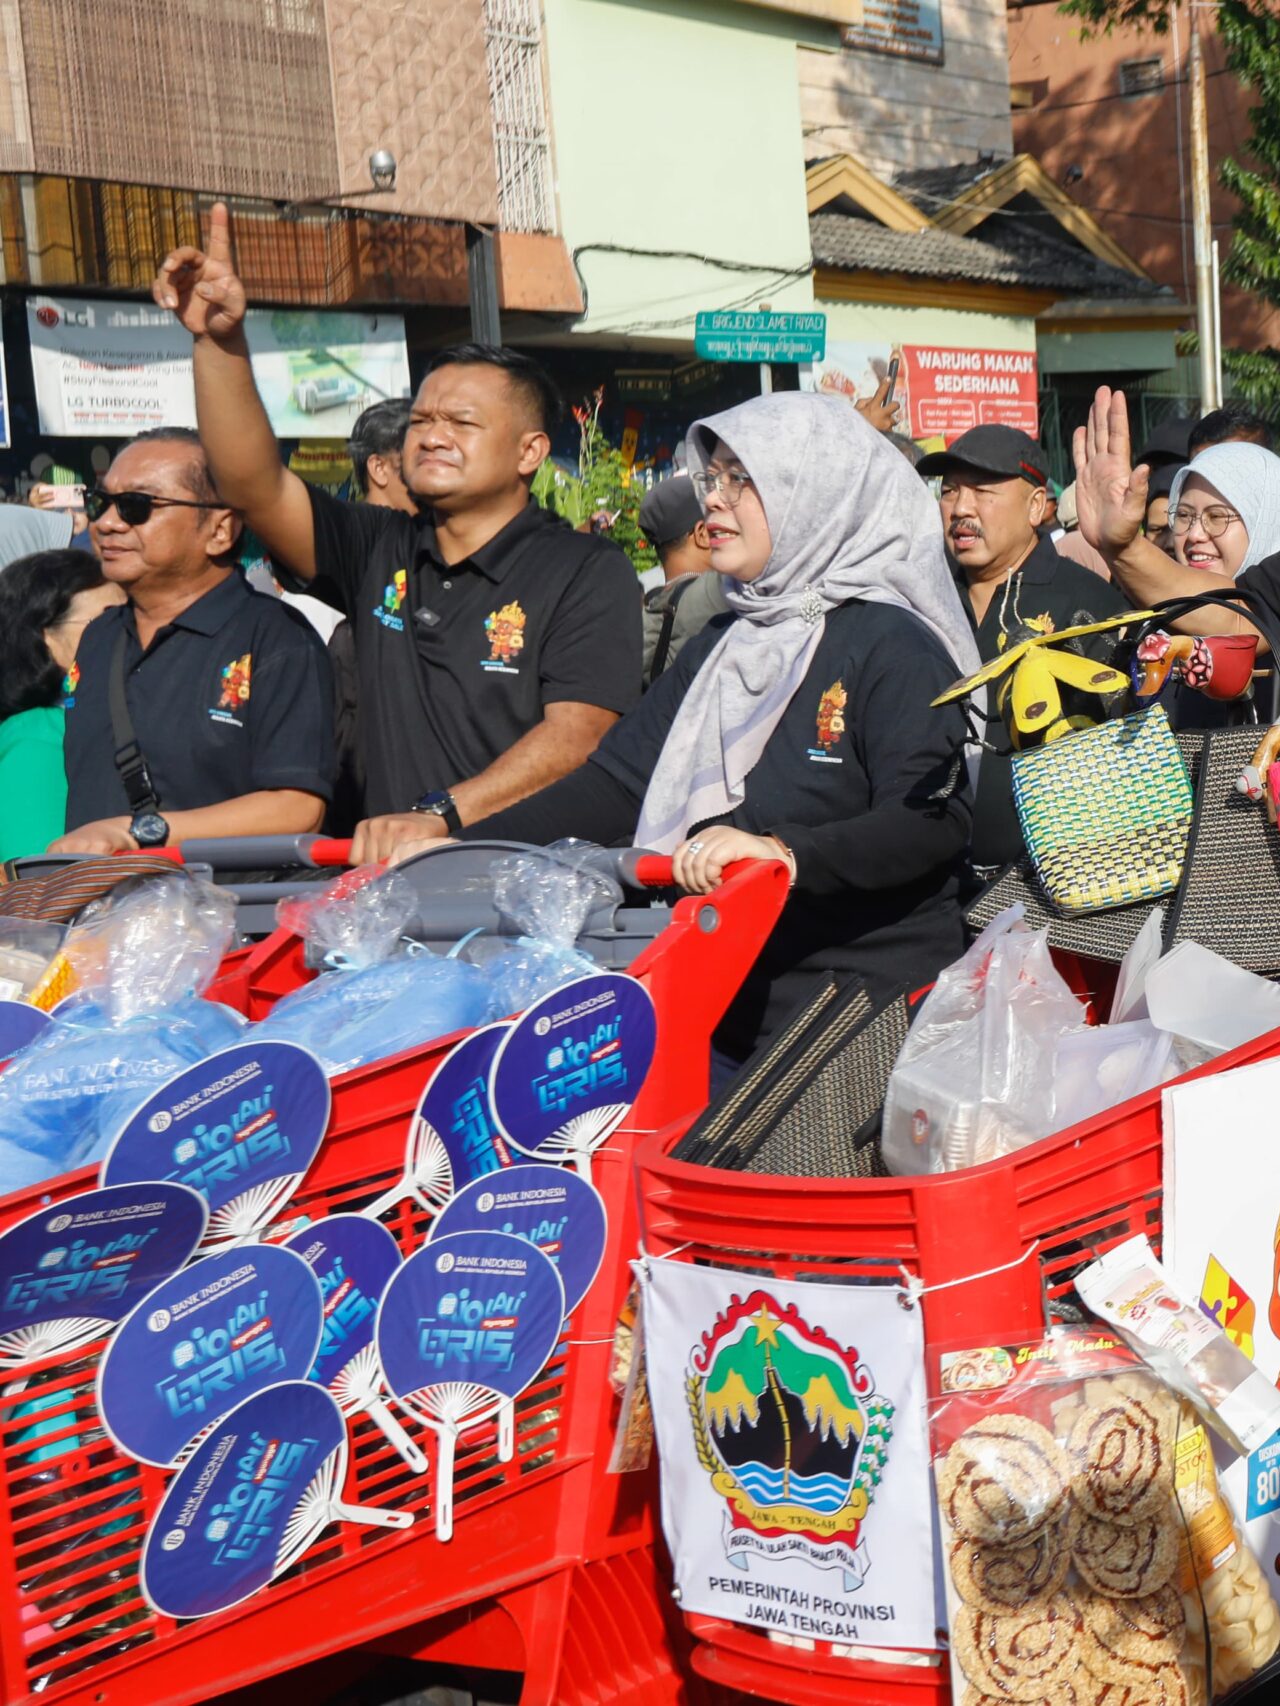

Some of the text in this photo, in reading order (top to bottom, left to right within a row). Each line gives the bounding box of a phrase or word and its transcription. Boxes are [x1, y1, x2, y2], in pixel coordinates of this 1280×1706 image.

[756, 315, 794, 330] SLAMET
[795, 315, 824, 331] RIYADI
[916, 351, 1033, 373] WARUNG MAKAN
[934, 375, 1020, 395] SEDERHANA
[67, 396, 162, 409] LG TURBOCOOL
[552, 1008, 573, 1023] BANK
[573, 990, 616, 1014] INDONESIA
[170, 1092, 202, 1115] BANK
[201, 1061, 260, 1097] INDONESIA
[538, 1052, 622, 1112] QRIS
[74, 1211, 106, 1222] BANK
[107, 1202, 166, 1218] INDONESIA
[496, 1192, 519, 1203] BANK
[520, 1187, 566, 1200] INDONESIA
[456, 1256, 527, 1269] BANK INDONESIA
[3, 1264, 133, 1313] QRIS
[170, 1292, 200, 1314] BANK
[200, 1264, 255, 1297] INDONESIA
[419, 1329, 515, 1368] QRIS
[1016, 1337, 1114, 1364] Intip Madu
[165, 1331, 279, 1418] QRIS
[174, 1496, 197, 1526] BANK
[192, 1434, 233, 1495] INDONESIA
[225, 1442, 309, 1559] QRIS
[751, 1510, 778, 1523] JAWA
[788, 1515, 836, 1529] TENGAH
[709, 1577, 895, 1621] PEMERINTAH PROVINSI
[745, 1603, 859, 1639] JAWA TENGAH
